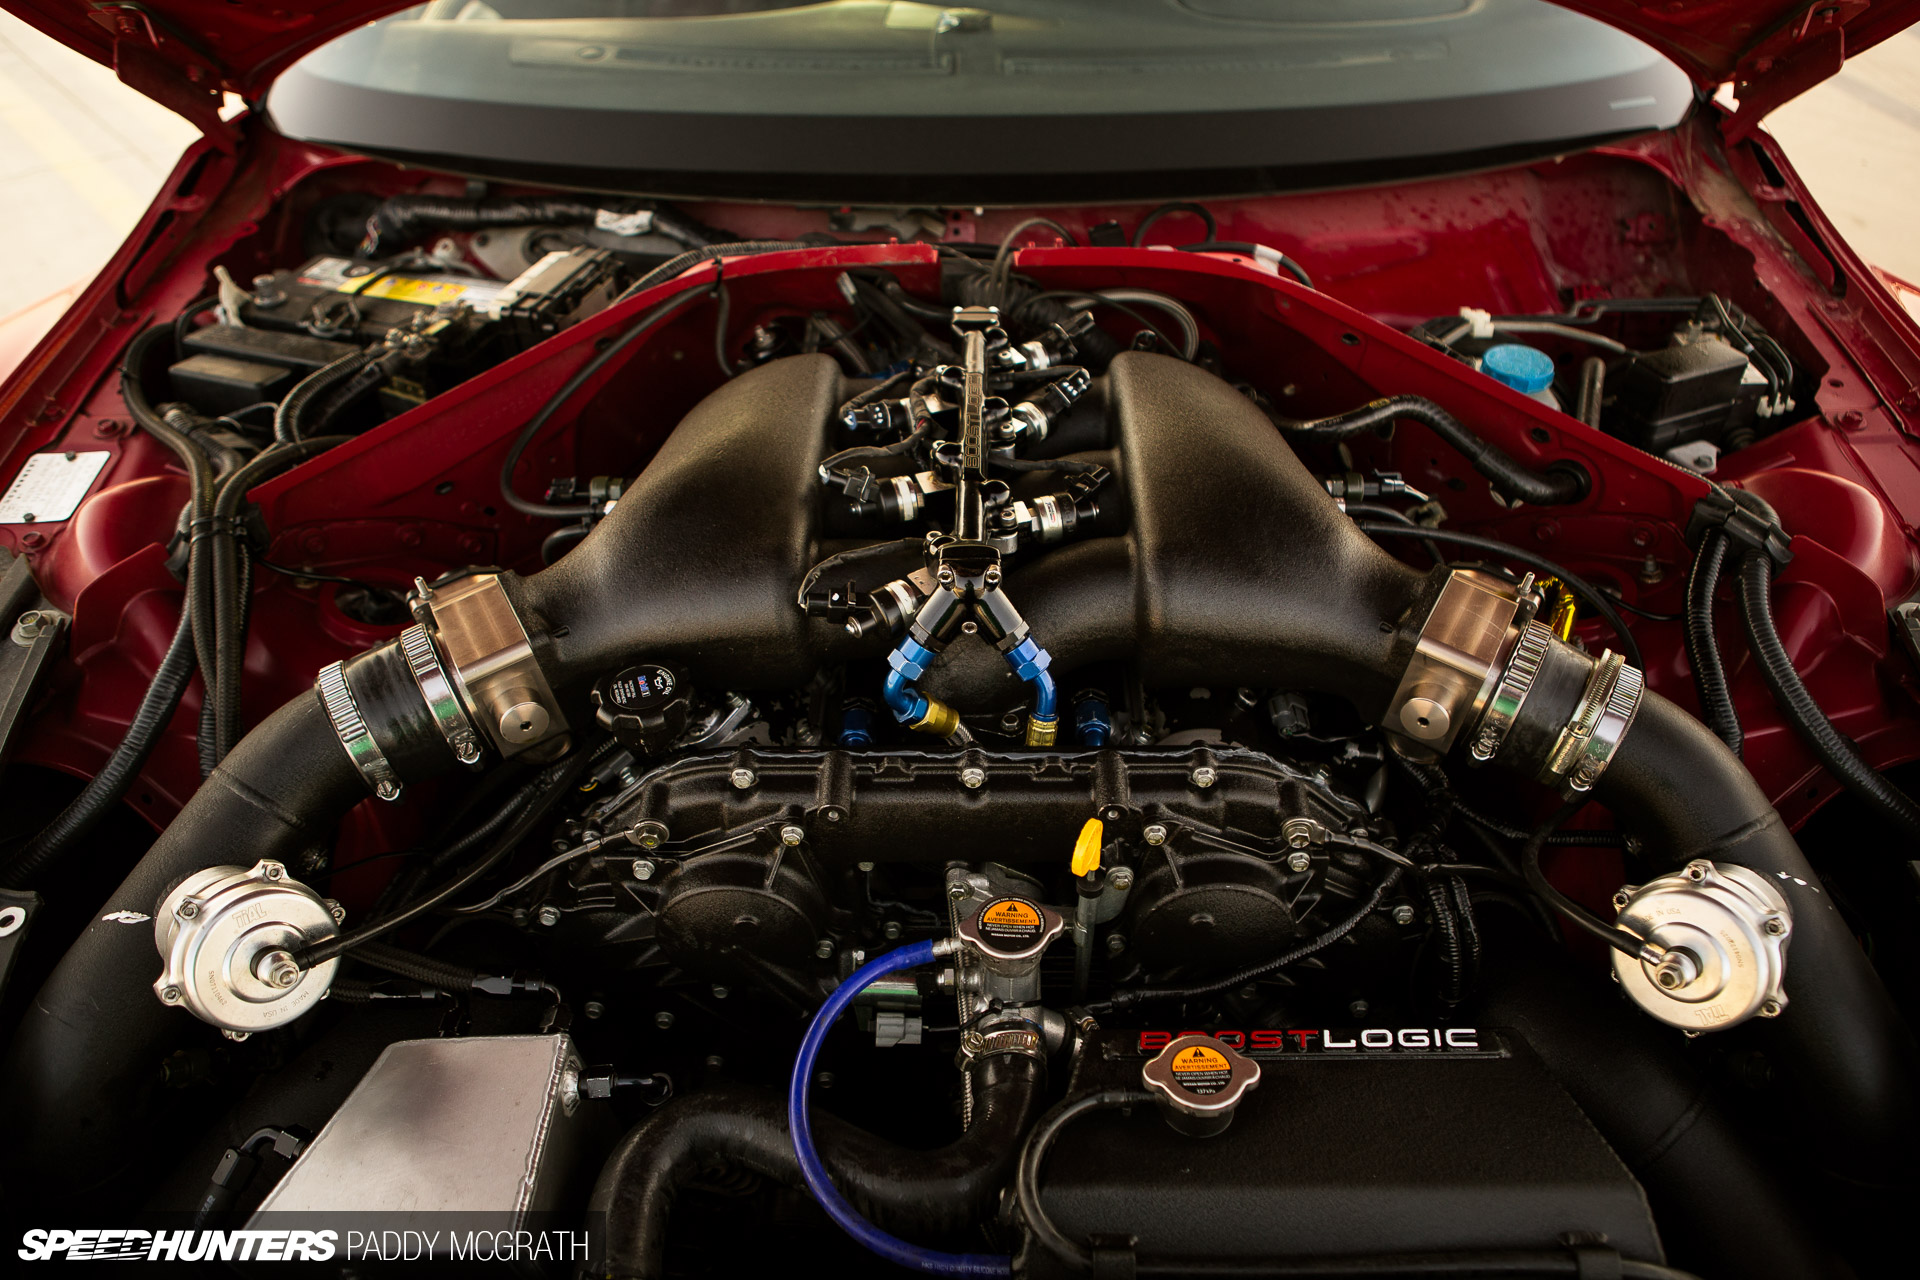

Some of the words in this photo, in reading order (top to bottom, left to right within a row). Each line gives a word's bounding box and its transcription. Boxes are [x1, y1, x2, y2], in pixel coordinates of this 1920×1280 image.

[637, 675, 650, 692] Mobil
[656, 669, 673, 686] ENGINE
[662, 686, 672, 696] OIL
[291, 990, 309, 1008] MADE
[262, 1010, 278, 1018] USA
[280, 1005, 289, 1014] IN
